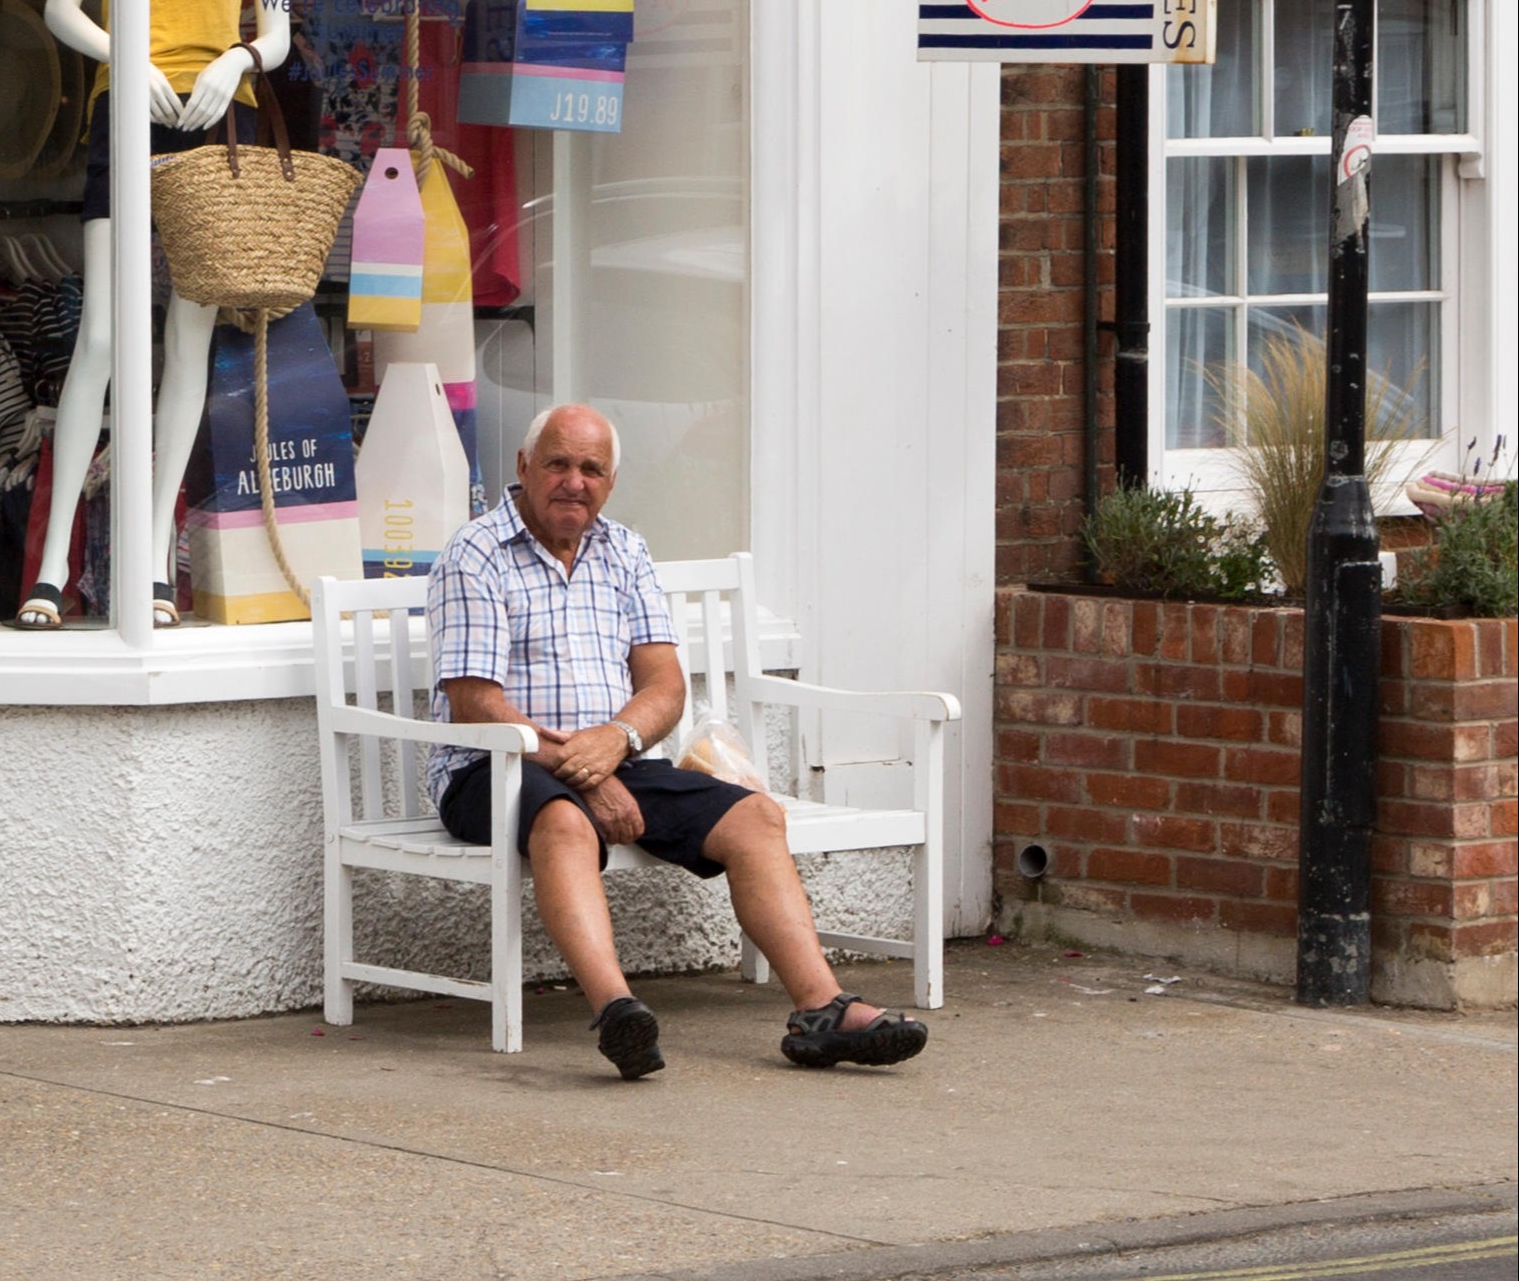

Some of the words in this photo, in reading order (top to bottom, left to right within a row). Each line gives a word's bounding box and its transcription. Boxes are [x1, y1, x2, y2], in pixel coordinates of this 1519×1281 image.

[549, 92, 619, 126] J19.89
[249, 440, 295, 462] JULES
[302, 439, 317, 458] OF
[237, 462, 336, 495] ALEBURGH
